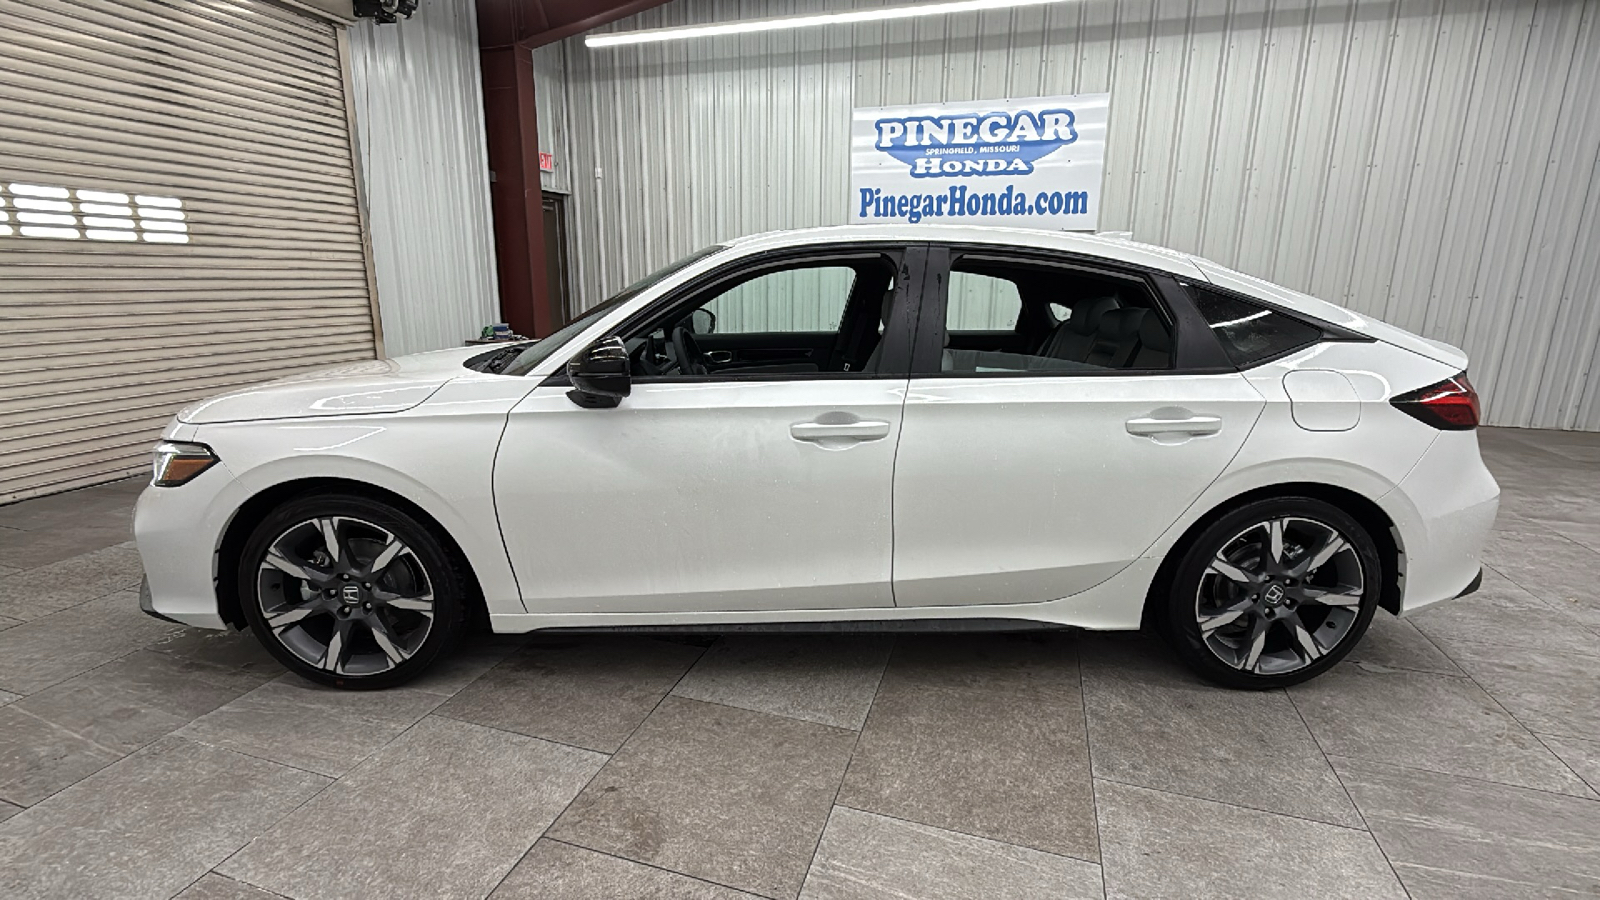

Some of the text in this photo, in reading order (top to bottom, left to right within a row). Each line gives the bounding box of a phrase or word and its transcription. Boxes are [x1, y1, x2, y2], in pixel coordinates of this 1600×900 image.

[879, 111, 1074, 148] PINEGAR
[925, 144, 1020, 156] SPRINGFIELD, MISSOURI
[859, 185, 1088, 223] PinegarHonda.com
